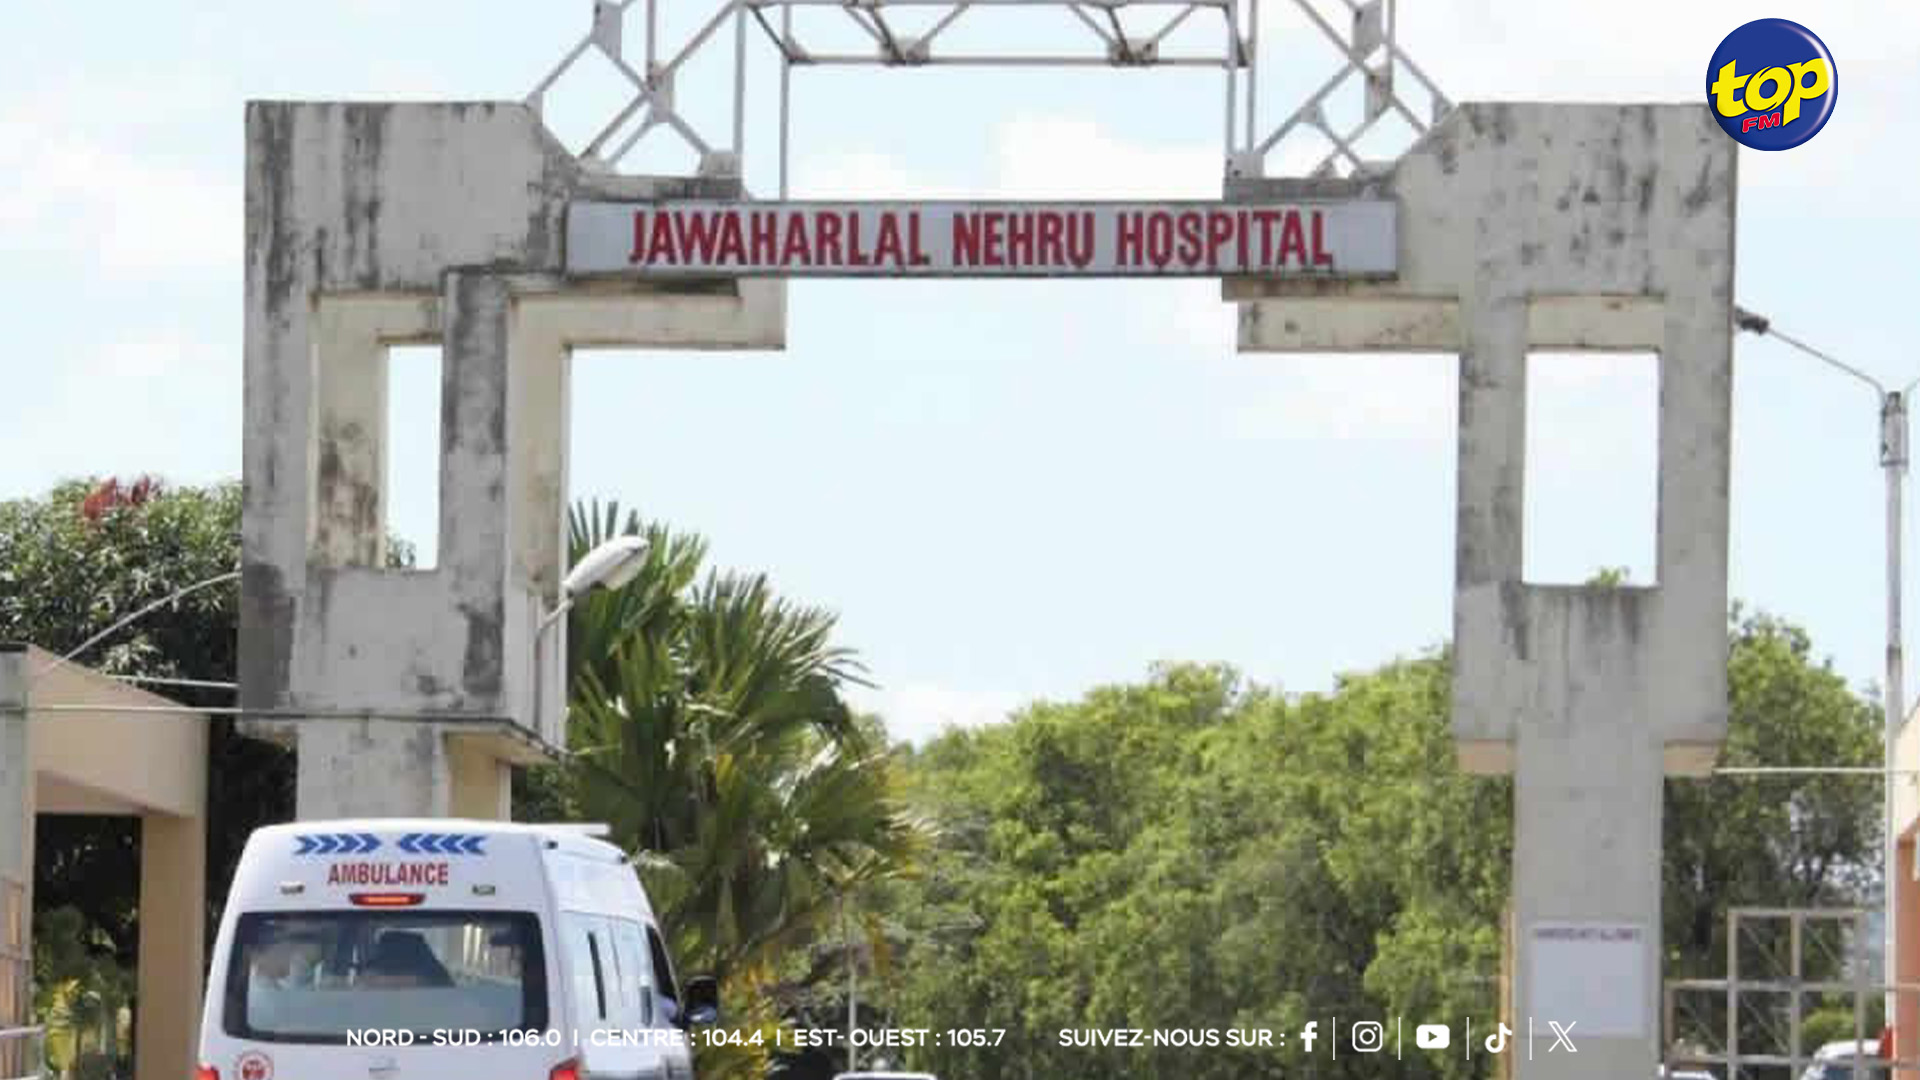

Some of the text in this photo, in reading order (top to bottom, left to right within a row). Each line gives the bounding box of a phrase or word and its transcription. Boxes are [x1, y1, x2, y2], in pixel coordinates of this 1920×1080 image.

[628, 209, 1334, 267] JAWAHARLAL NEHRU HOSPITAL
[327, 863, 450, 887] AMBULANCE
